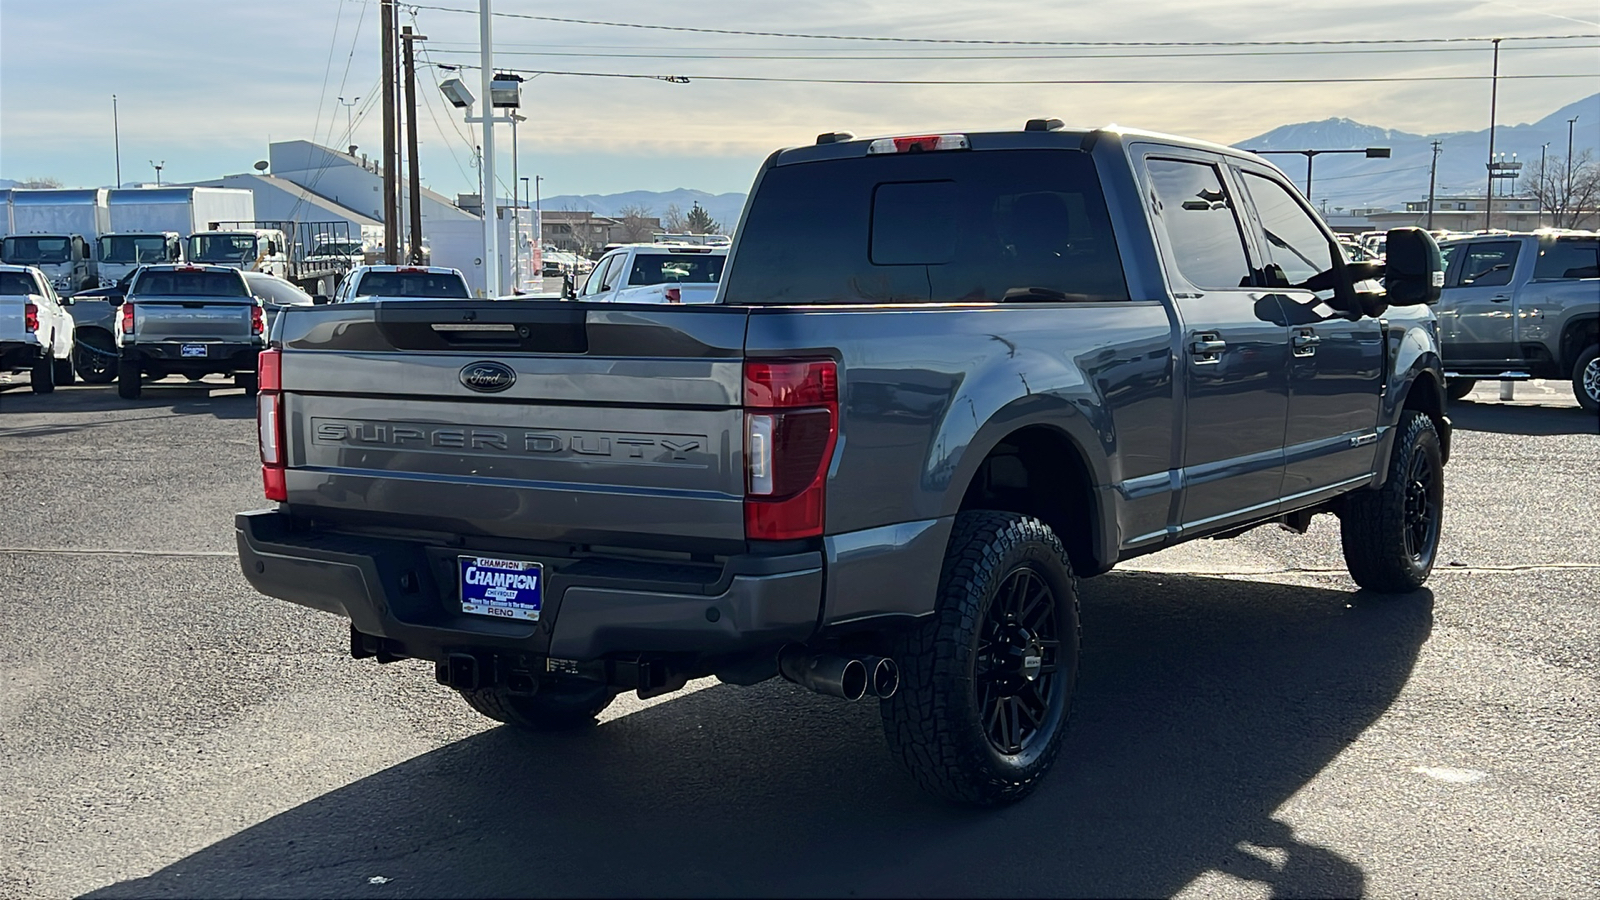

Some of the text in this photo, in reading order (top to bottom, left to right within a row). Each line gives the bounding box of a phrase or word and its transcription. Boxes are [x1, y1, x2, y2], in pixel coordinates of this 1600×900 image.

[470, 367, 501, 385] Ford
[318, 423, 700, 461] SUPER DUTY
[480, 558, 519, 569] CHAMPION
[465, 566, 537, 590] CHAMPION
[487, 607, 514, 617] RENO
